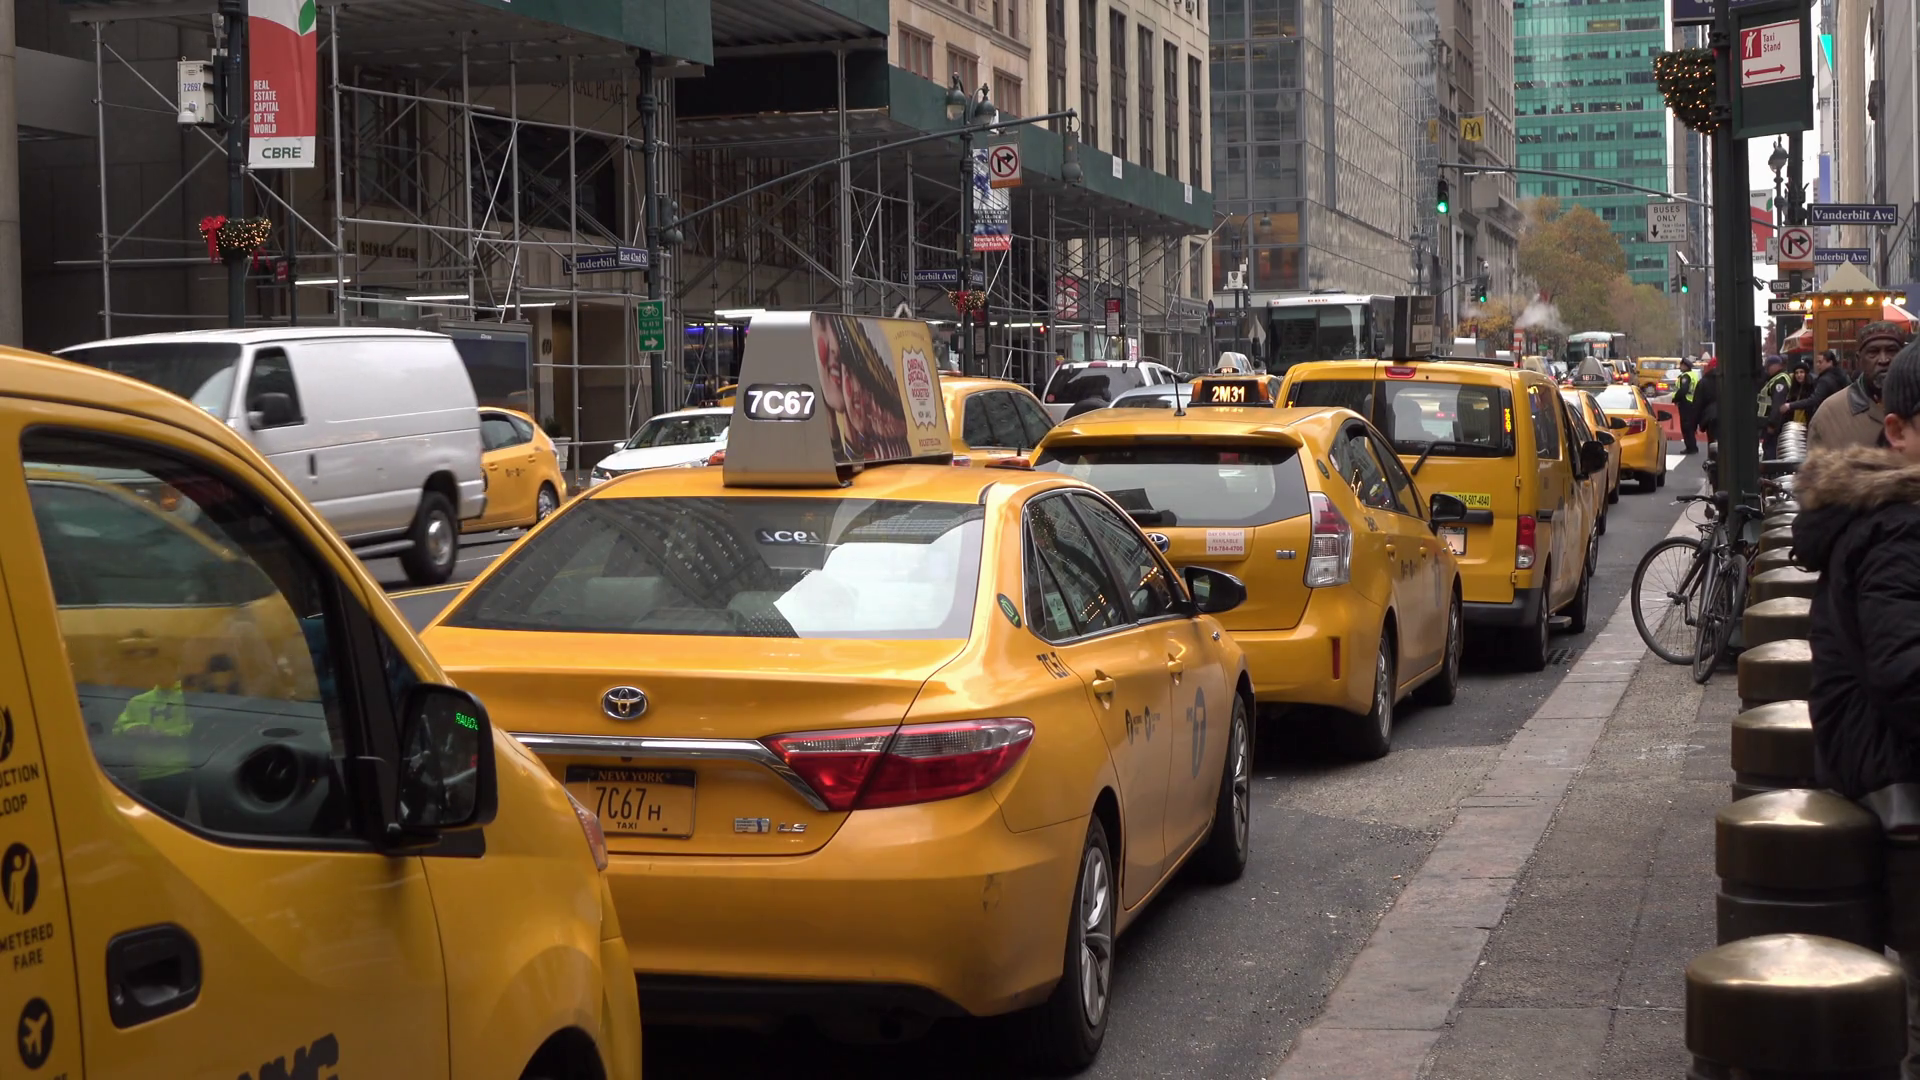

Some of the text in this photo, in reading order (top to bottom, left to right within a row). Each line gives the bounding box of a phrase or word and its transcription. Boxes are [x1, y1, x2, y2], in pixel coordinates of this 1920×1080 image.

[1763, 32, 1775, 42] Taxi
[1763, 41, 1781, 52] Stand
[183, 83, 201, 92] 72697
[253, 80, 270, 90] REAL
[253, 91, 276, 101] ESTATE
[253, 102, 279, 112] CAPITAL
[253, 113, 275, 123] OF THE
[253, 124, 277, 134] WORLD
[262, 147, 301, 159] CBRE
[1814, 210, 1894, 220] Vanderbilt Ave
[620, 251, 647, 263] East 42nd St
[1851, 253, 1867, 261] Ave
[902, 272, 956, 281] Vnderbilt Ave
[1212, 386, 1246, 402] 2M31
[748, 391, 815, 414] 7C67
[598, 770, 665, 783] NEW YORK
[616, 821, 637, 830] TAXI
[13, 948, 43, 971] FARE
